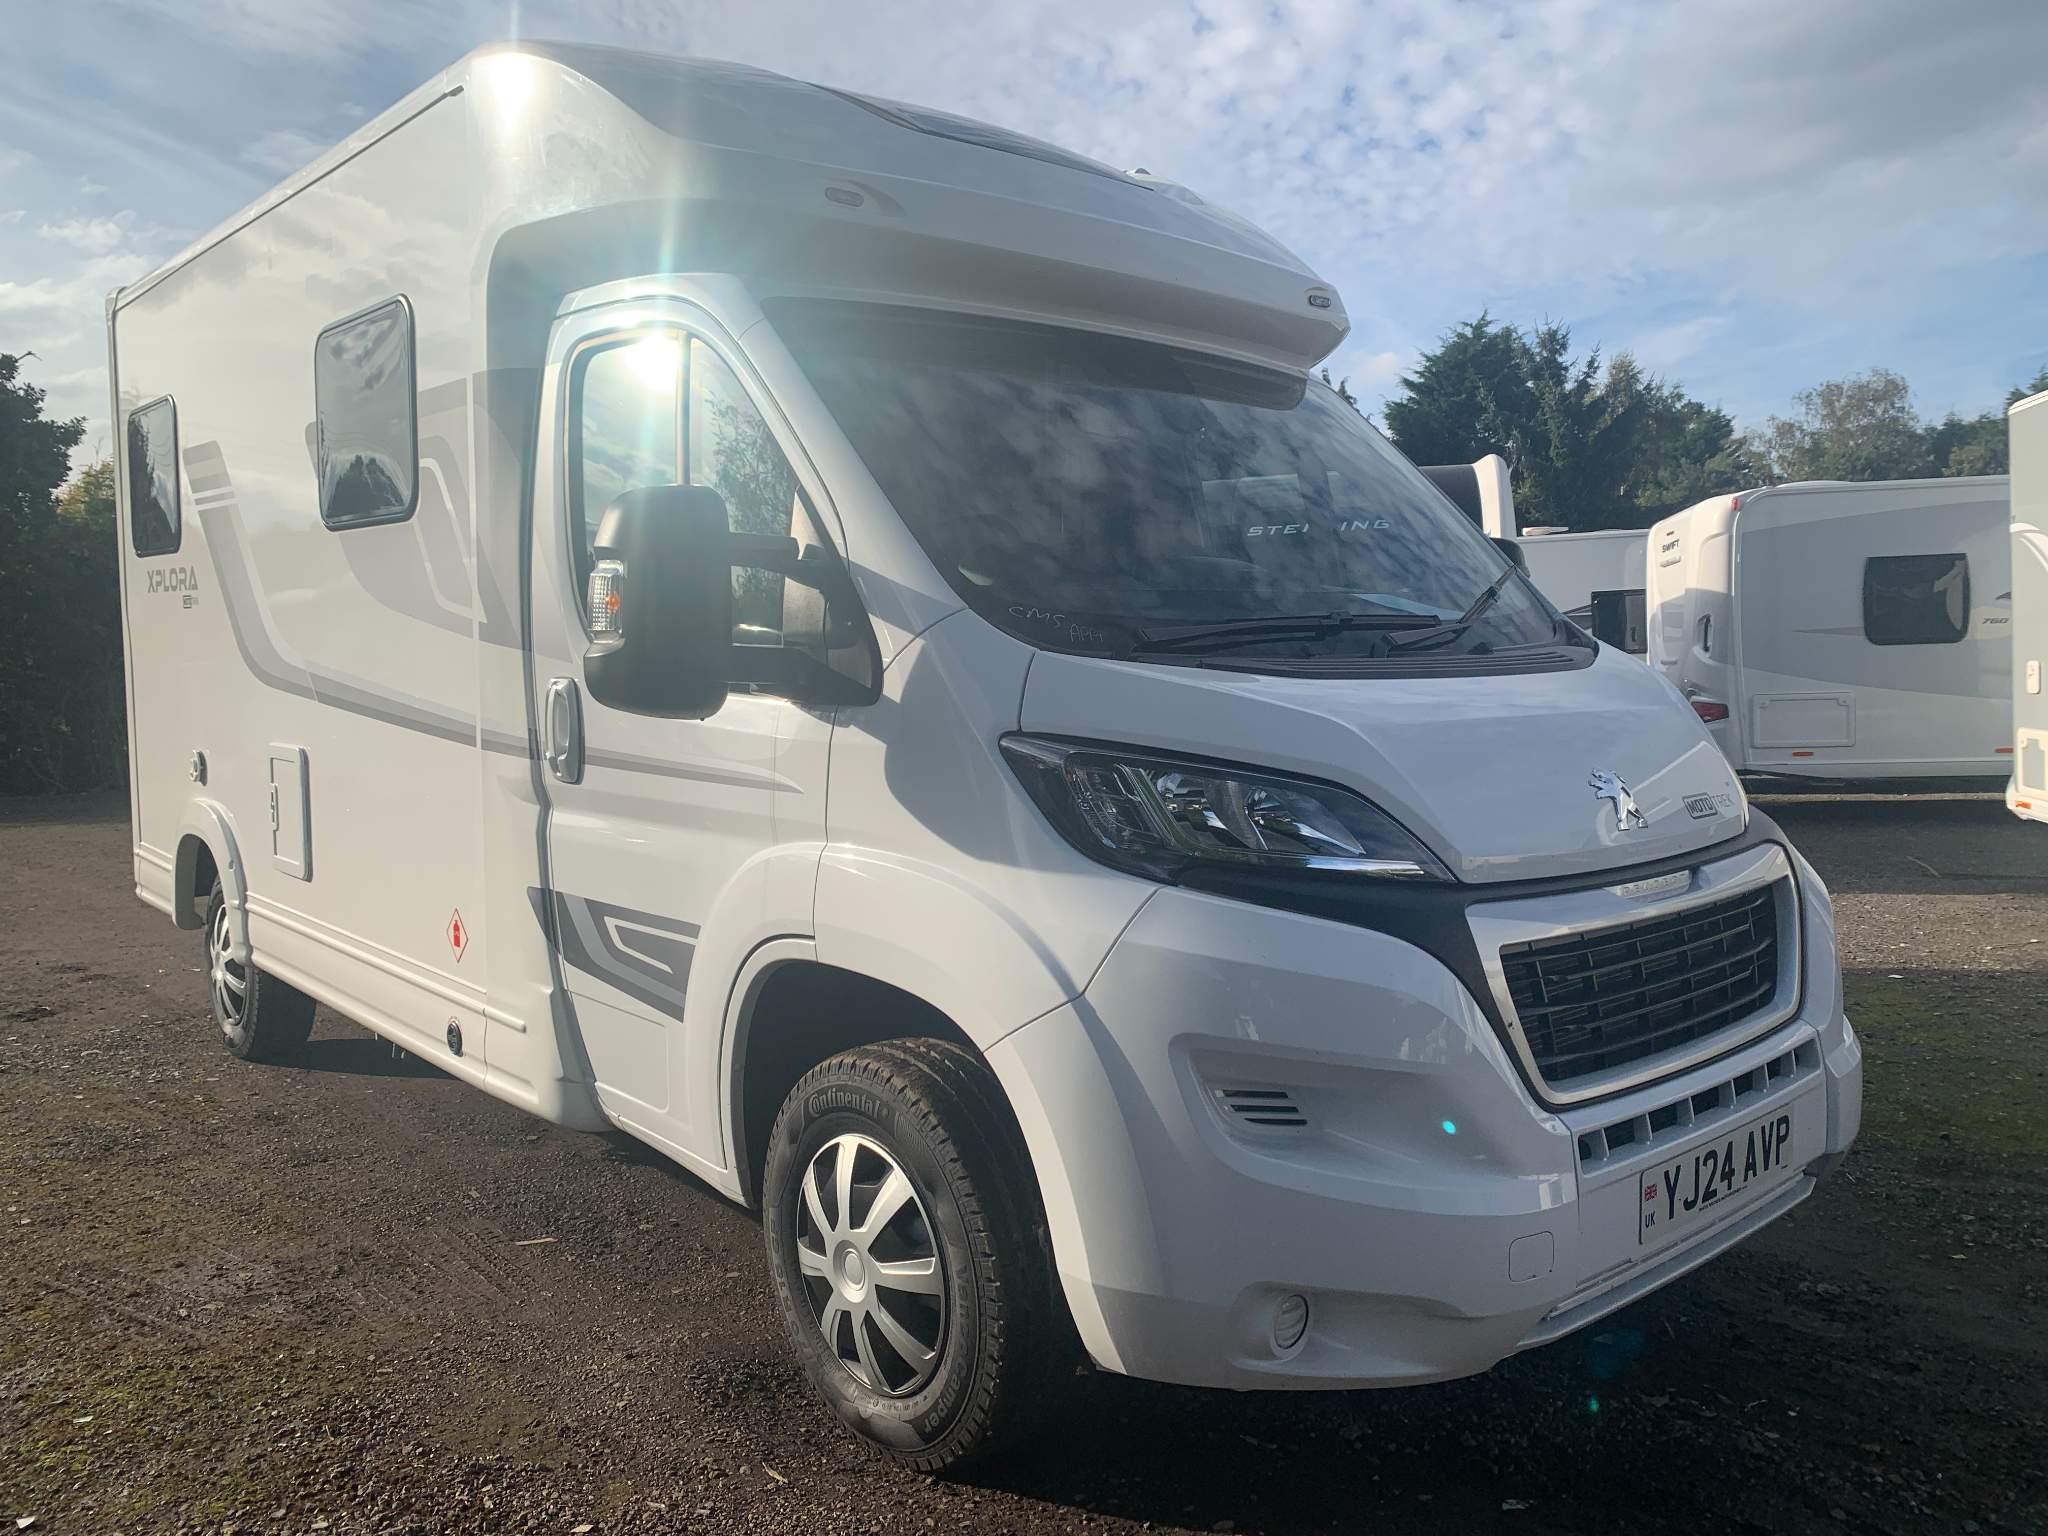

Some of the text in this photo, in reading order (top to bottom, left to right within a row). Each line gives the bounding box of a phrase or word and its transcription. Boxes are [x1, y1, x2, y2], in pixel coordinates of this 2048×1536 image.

[1661, 538, 1680, 553] SWIFT
[147, 565, 199, 593] XPLORA
[808, 1087, 881, 1119] Continental
[1663, 1114, 1790, 1221] YJ24 AVP
[1644, 1211, 1656, 1229] UK
